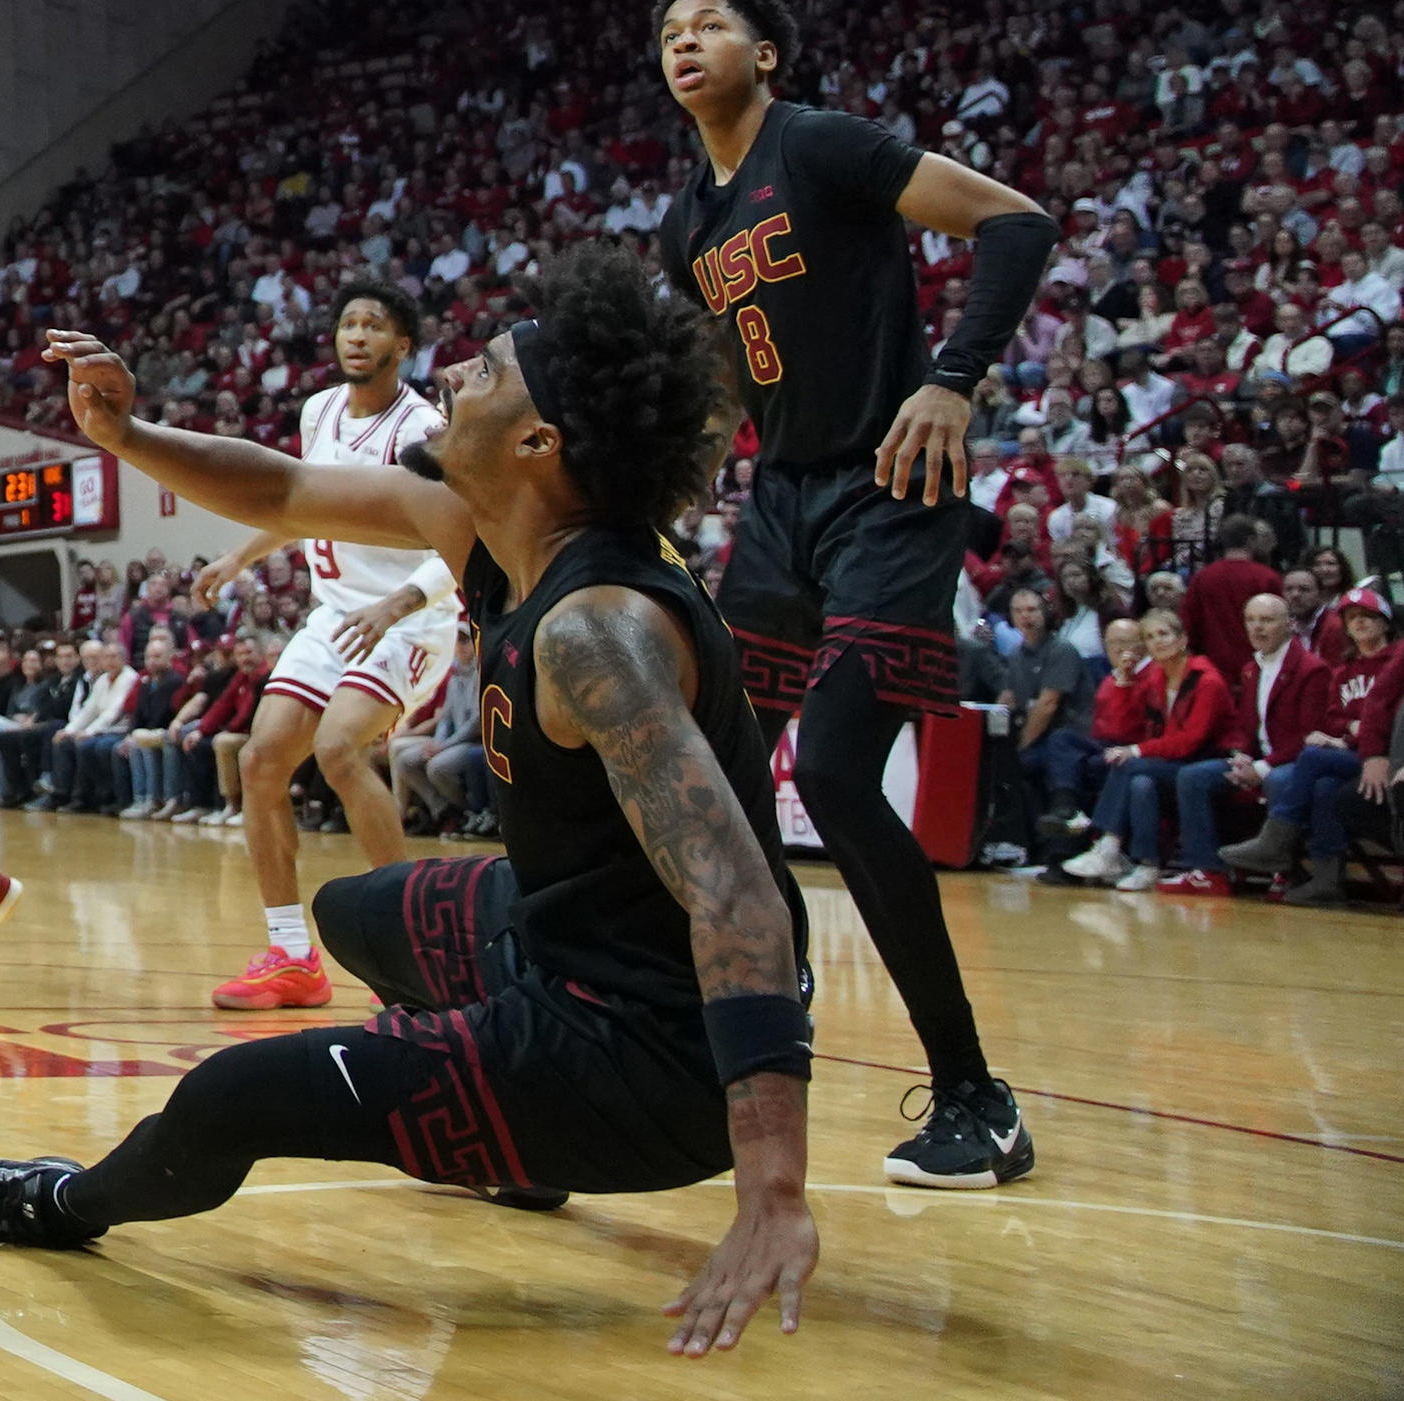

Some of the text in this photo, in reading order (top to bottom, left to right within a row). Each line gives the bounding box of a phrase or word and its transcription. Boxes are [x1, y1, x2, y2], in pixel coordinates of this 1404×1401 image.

[692, 211, 807, 316] USC
[736, 304, 783, 385] 8
[314, 539, 342, 580] 9
